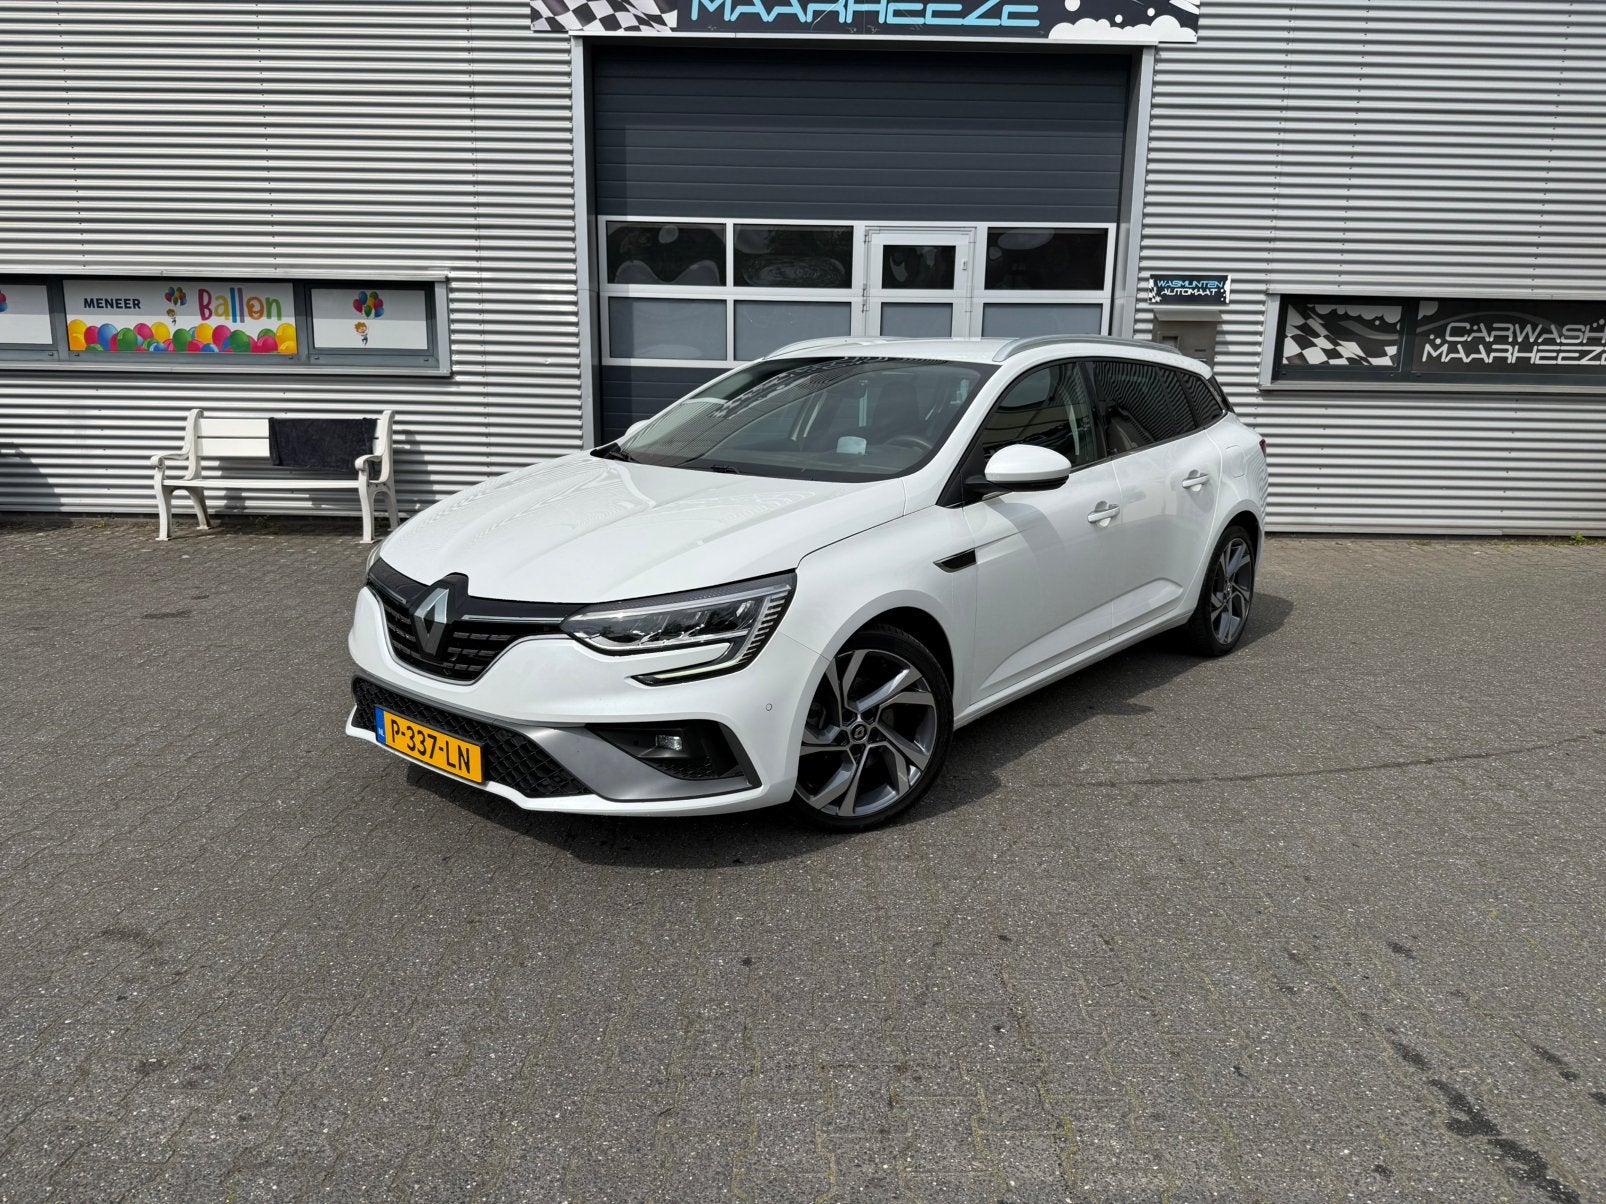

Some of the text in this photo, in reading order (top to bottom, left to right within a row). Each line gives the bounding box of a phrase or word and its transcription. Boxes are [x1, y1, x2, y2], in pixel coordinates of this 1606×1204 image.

[1157, 280, 1223, 288] WASMUNTEN
[1160, 288, 1218, 296] AUTOMAAT
[83, 287, 282, 324] MENEER Ballon
[1445, 322, 1606, 343] CARWASH
[1422, 343, 1606, 365] MAARHEEZ
[390, 718, 471, 774] P-337-LN
